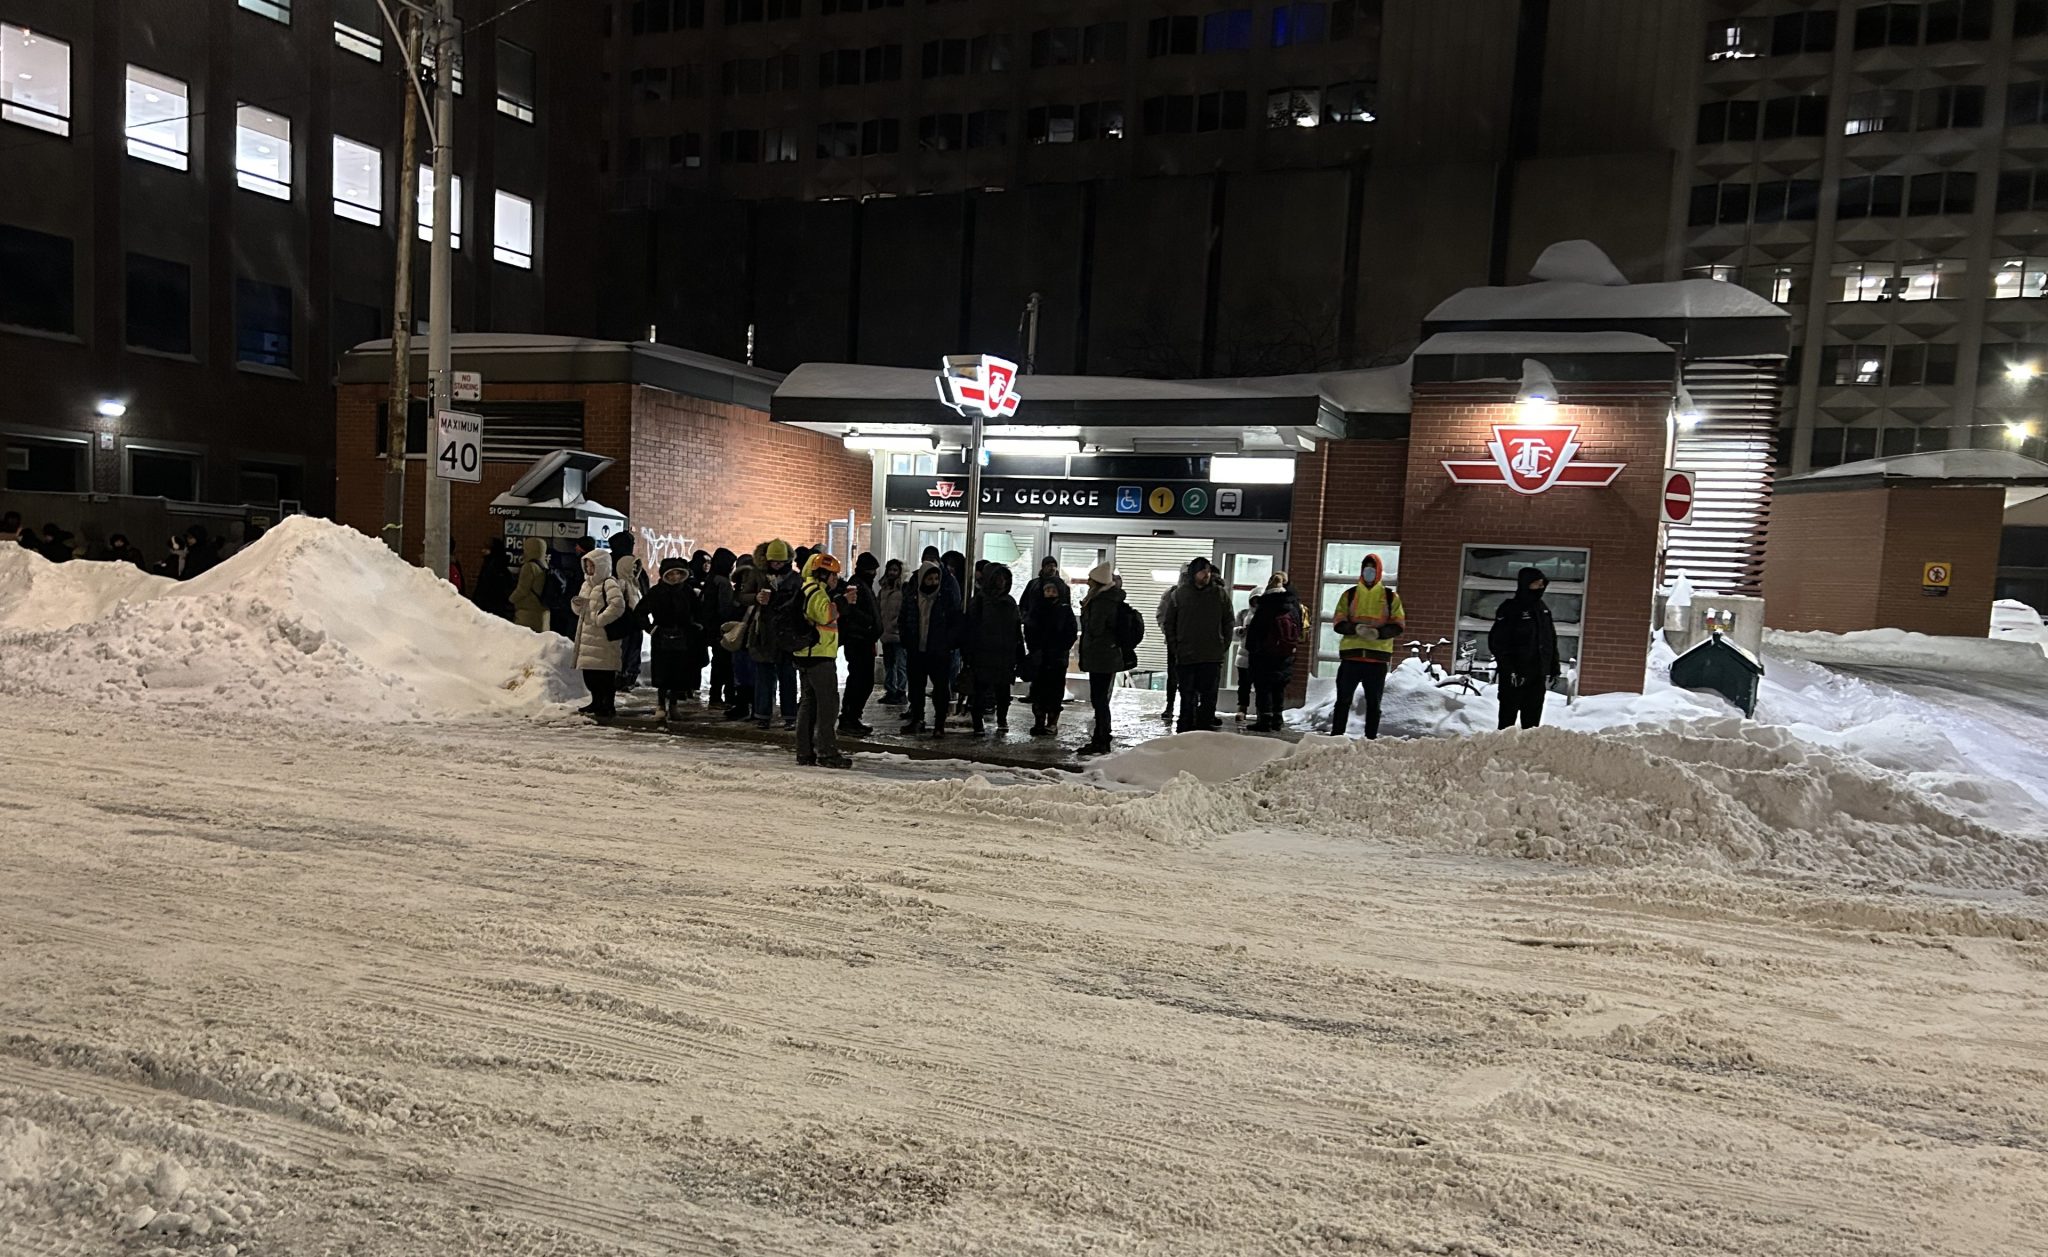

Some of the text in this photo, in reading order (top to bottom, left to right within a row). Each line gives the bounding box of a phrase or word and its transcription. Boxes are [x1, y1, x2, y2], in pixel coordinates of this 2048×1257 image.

[461, 374, 471, 382] NO
[453, 382, 479, 391] STANDING
[440, 417, 479, 433] MAXIMUM
[440, 440, 478, 472] 40
[981, 487, 1099, 506] ST GEORGE
[1158, 493, 1165, 508] 1
[1189, 494, 1199, 508] 2
[929, 499, 961, 508] SUBWAY
[497, 507, 520, 517] George
[506, 522, 534, 534] 24/7
[505, 536, 526, 549] Pic
